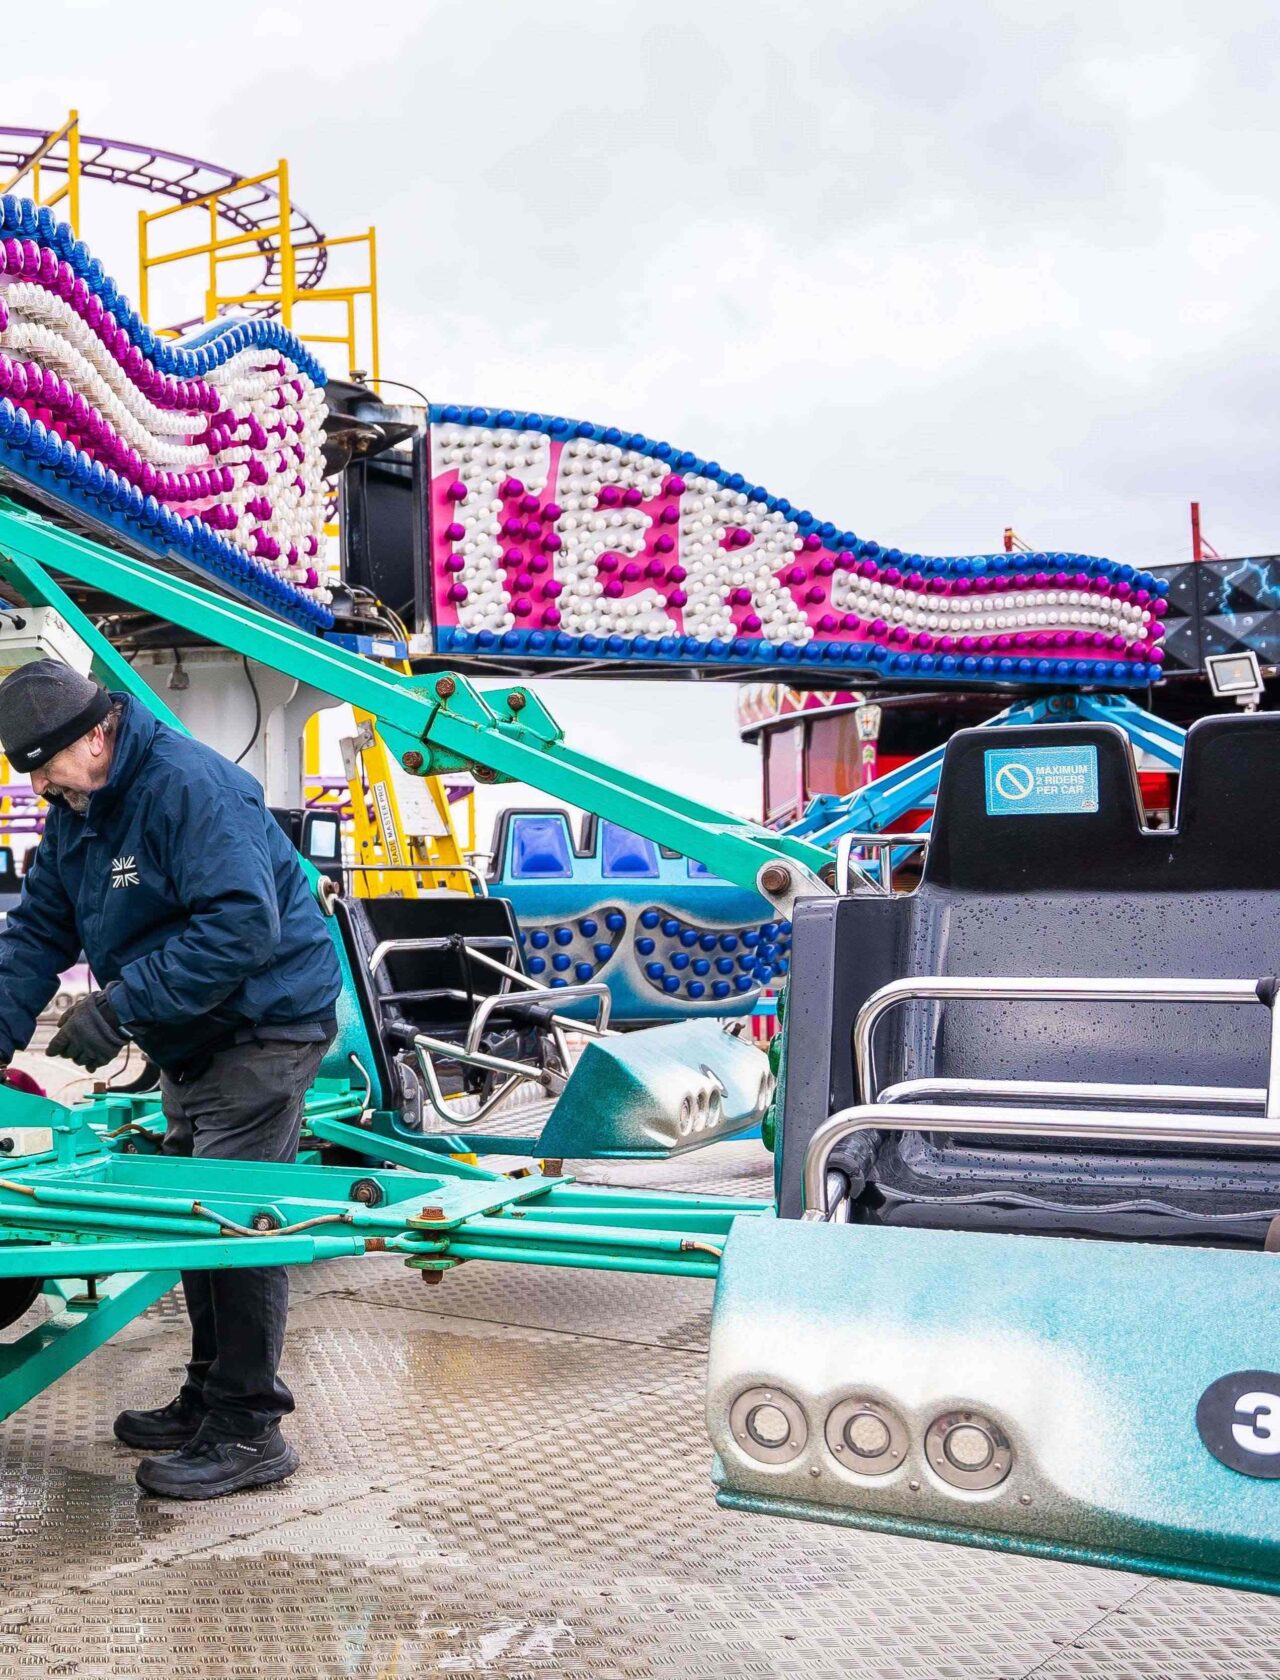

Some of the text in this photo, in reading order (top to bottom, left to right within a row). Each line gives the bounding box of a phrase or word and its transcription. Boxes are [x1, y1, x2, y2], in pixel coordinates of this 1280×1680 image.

[431, 422, 814, 647] TER
[1035, 765, 1088, 775] MAXIMUM
[1036, 775, 1085, 785] 2 RIDERS
[1036, 786, 1084, 794] PER CAR
[376, 785, 400, 864] RADE MASTER PRO
[1231, 1391, 1280, 1456] 3
